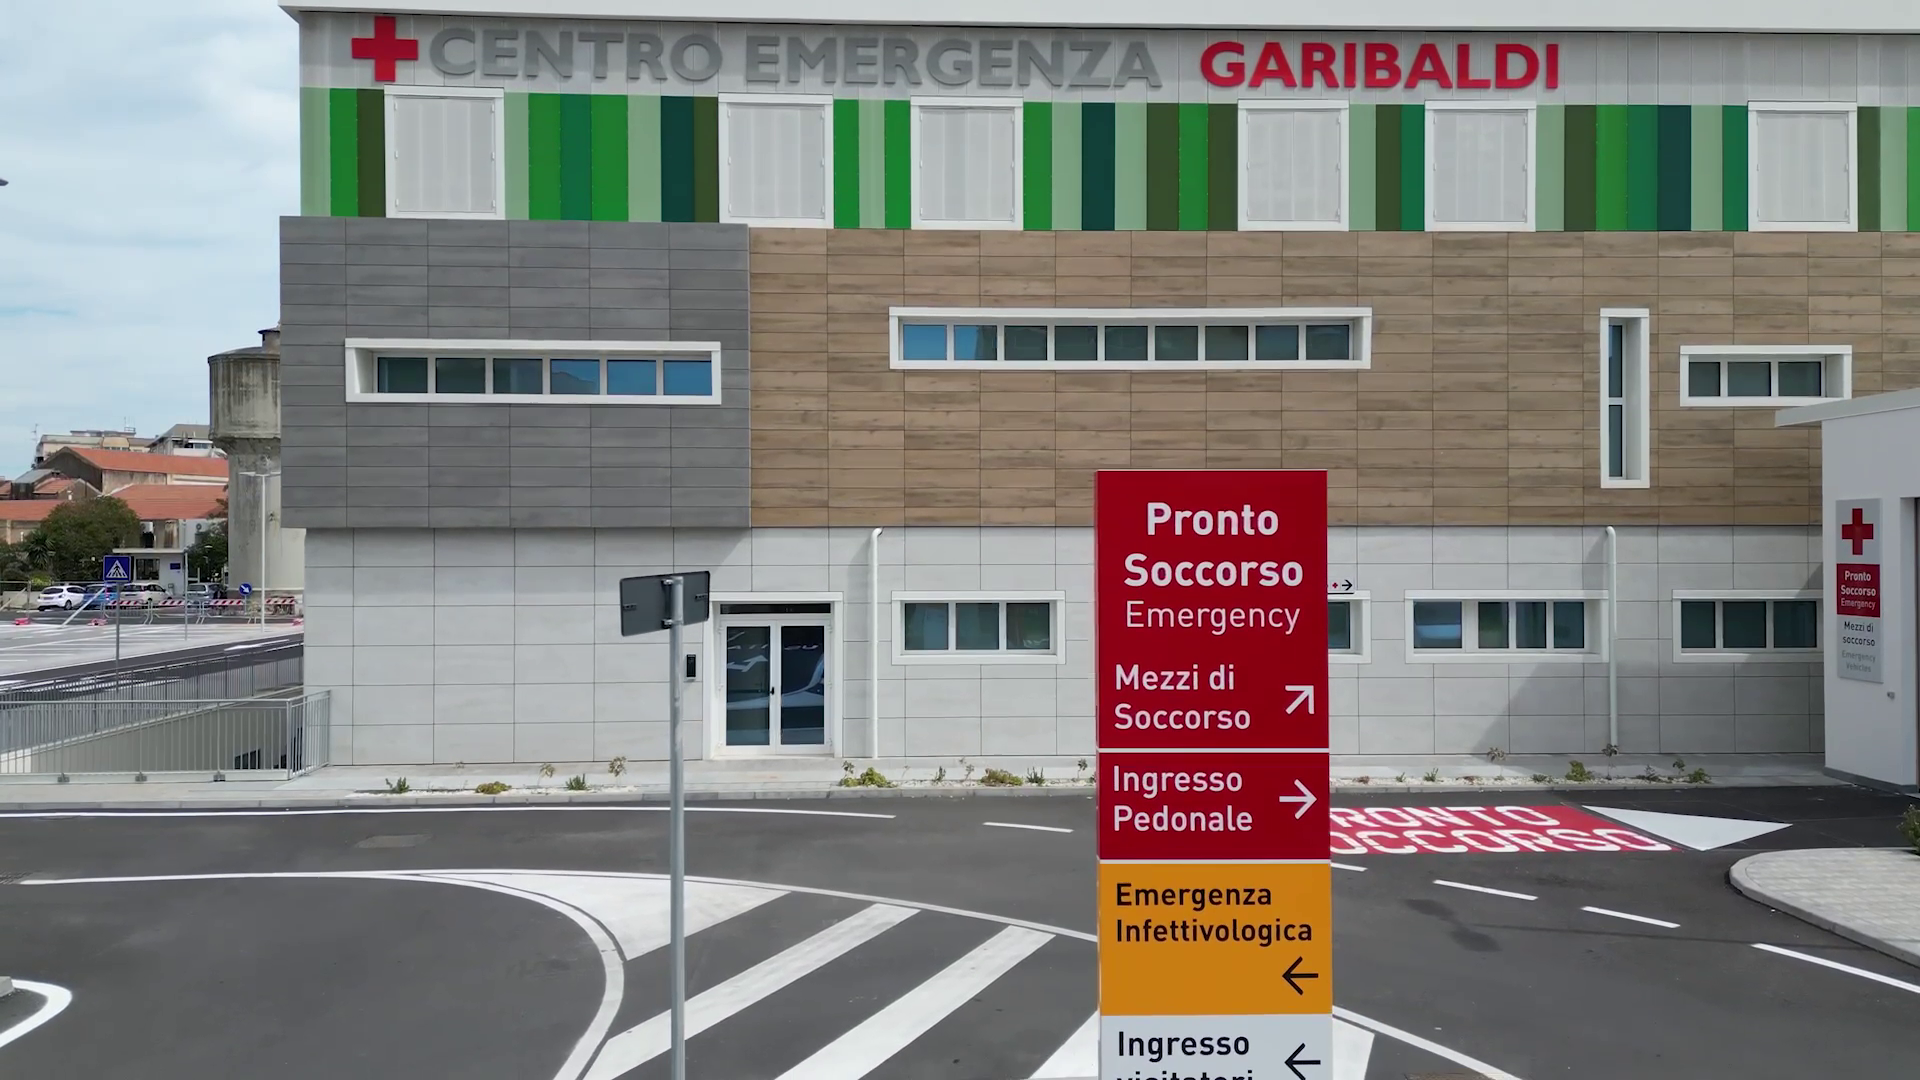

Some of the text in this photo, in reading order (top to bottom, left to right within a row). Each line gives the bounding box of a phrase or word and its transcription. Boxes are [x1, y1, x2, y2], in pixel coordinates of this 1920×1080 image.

[429, 28, 1559, 89] CENTRO EMERGENZA GARIBALDI
[1147, 502, 1279, 536] Pronto
[1124, 553, 1304, 587] Soccorso
[1844, 570, 1871, 581] Pronto
[1840, 584, 1876, 596] Soccorso
[1841, 598, 1876, 610] Emergency
[1126, 600, 1301, 635] Emergency
[1844, 621, 1874, 632] Mezzi di
[1842, 636, 1875, 646] soccorso
[1115, 664, 1235, 690] Mezzi di
[1114, 703, 1251, 730] Soccorso
[1112, 765, 1243, 798] Ingresso
[1113, 805, 1253, 831] Pedonale
[1330, 806, 1560, 828] RONTO
[1330, 829, 1672, 854] OCCORSO
[1116, 883, 1272, 911] Emergenza
[1116, 919, 1313, 947] Infettivologica
[1118, 1031, 1250, 1063] Ingresso
